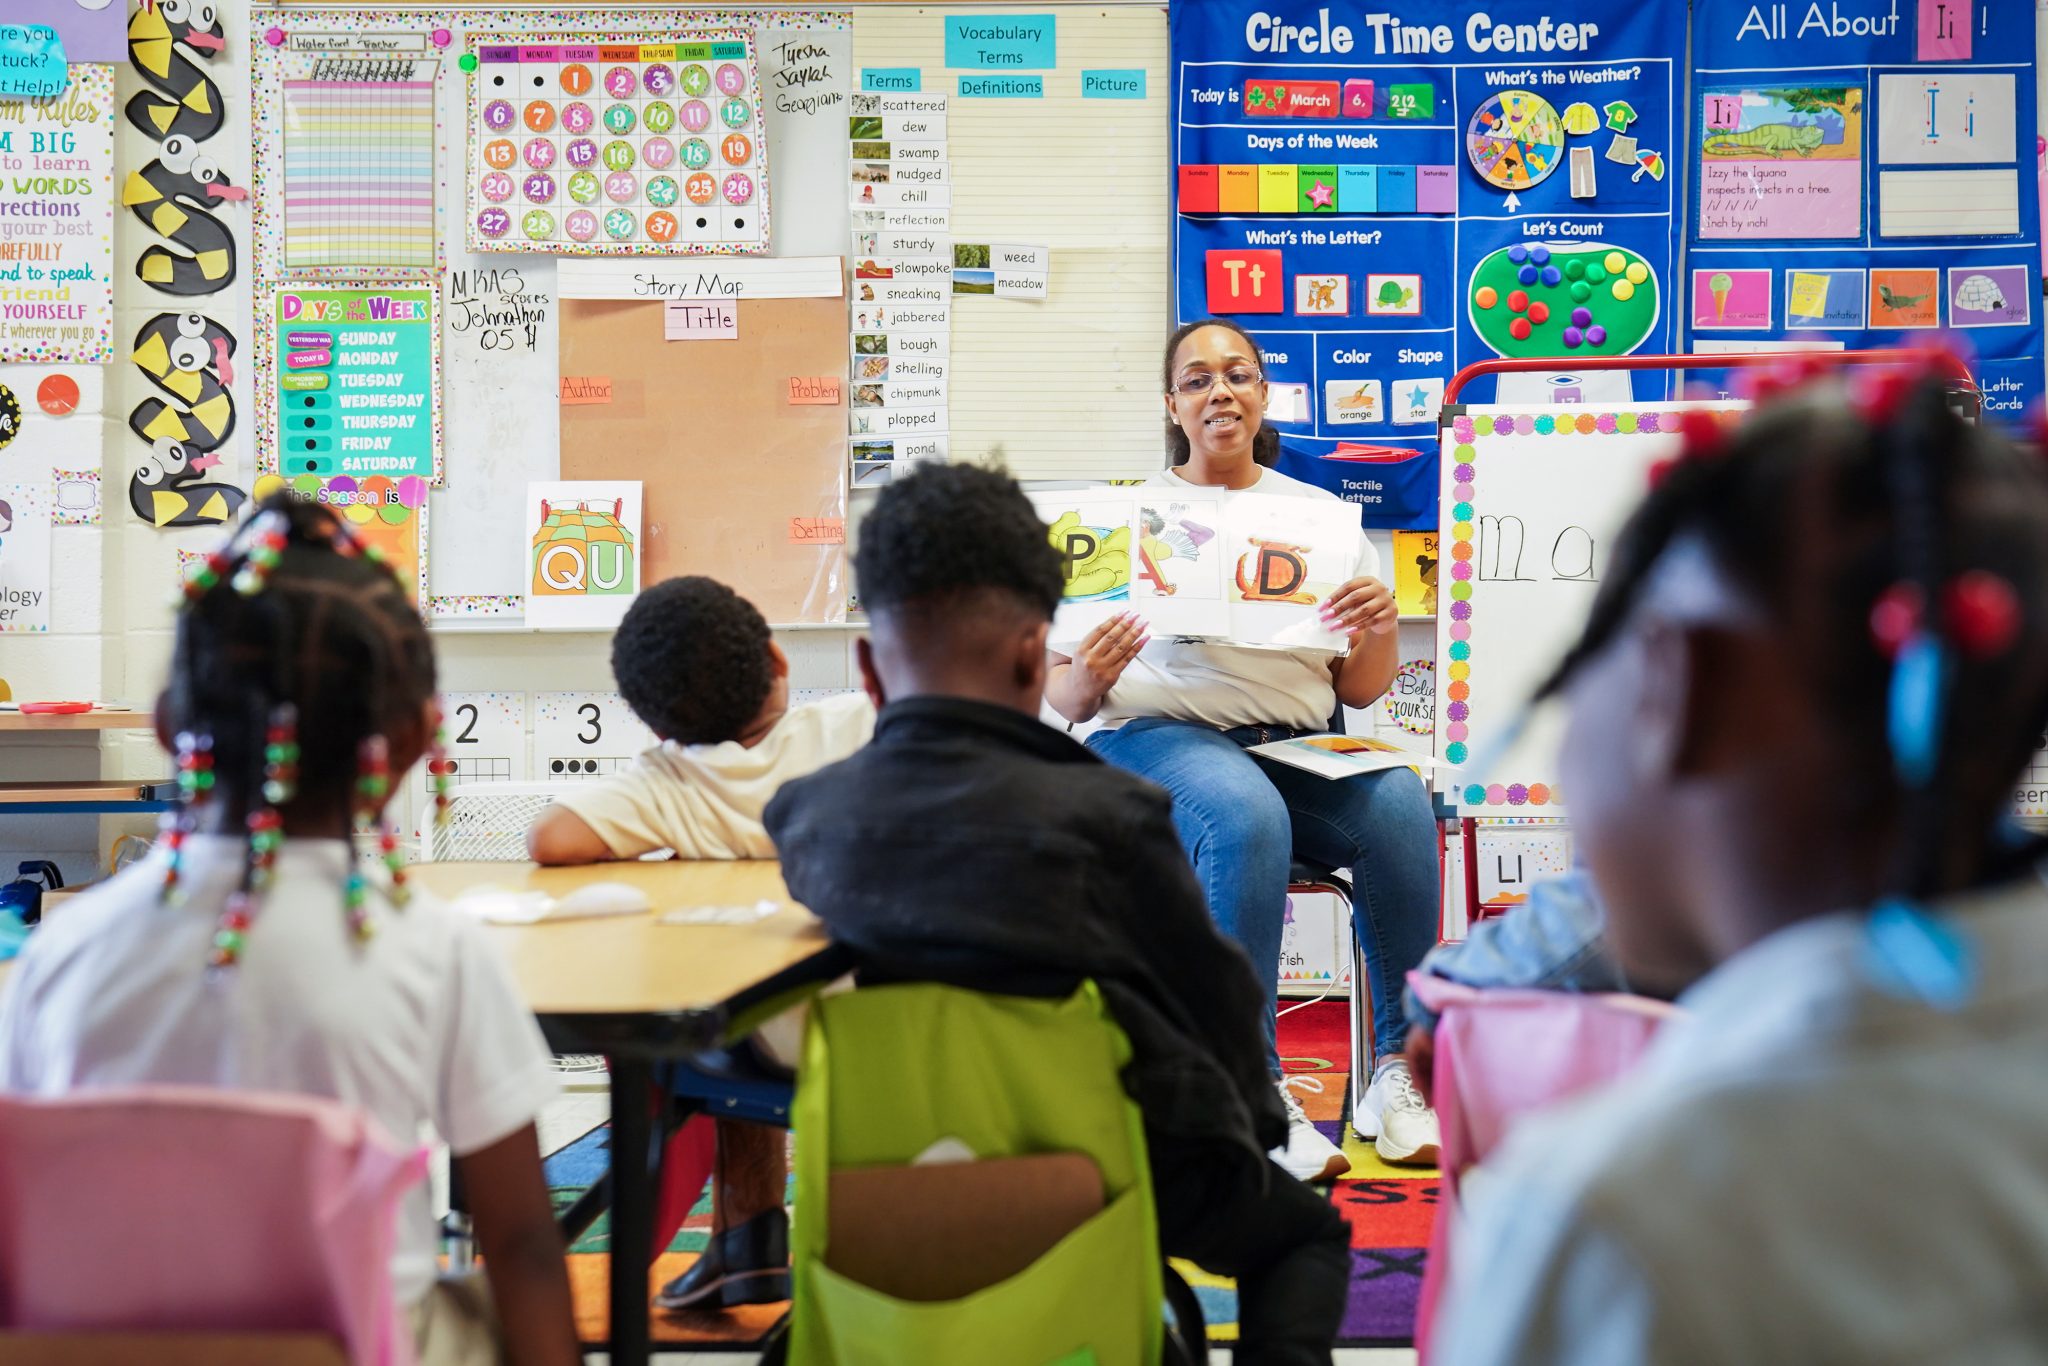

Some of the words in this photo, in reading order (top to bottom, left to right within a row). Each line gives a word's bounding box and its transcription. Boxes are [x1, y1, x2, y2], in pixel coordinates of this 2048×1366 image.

[1736, 4, 1786, 41] All
[1797, 0, 1900, 38] About
[24, 29, 54, 43] you
[959, 26, 1041, 42] Vocabulary
[1246, 8, 1354, 54] Circle
[1366, 13, 1453, 54] Time
[1466, 12, 1599, 53] Center
[526, 51, 553, 59] MONDAY
[565, 50, 594, 59] TUESDAY
[602, 51, 635, 60] WEDNESDAY
[643, 50, 674, 59] THURSDAY
[685, 49, 704, 57] FRIDAY
[714, 47, 744, 56] SATURDAY
[978, 51, 1023, 63] Terms
[572, 70, 581, 91] 1
[613, 74, 628, 94] 2
[651, 69, 667, 89] 3
[687, 71, 702, 91] 4
[723, 70, 738, 90] 5
[867, 74, 913, 88] Terms
[1486, 70, 1537, 85] What's
[1542, 70, 1566, 84] the
[1570, 66, 1641, 84] Weather?
[14, 80, 60, 97] Help!
[962, 81, 1041, 94] Definitions
[1087, 77, 1138, 91] Picture
[883, 99, 945, 111] scattered
[1191, 89, 1225, 105] Today
[1229, 88, 1239, 102] is
[1290, 94, 1330, 106] March
[1352, 93, 1366, 107] 6,
[492, 105, 506, 124] 6
[531, 106, 547, 126] 7
[570, 108, 585, 127] 8
[612, 109, 628, 129] 9
[649, 107, 669, 127] 10
[687, 106, 702, 125] 11
[726, 103, 745, 122] 12
[1713, 99, 1731, 124] Ii
[902, 121, 927, 133] dew
[29, 132, 76, 153] BIG
[1247, 134, 1284, 151] Days
[1287, 134, 1304, 149] of
[1308, 134, 1334, 148] the
[1336, 135, 1378, 149] Week
[489, 145, 511, 164] 13
[529, 144, 550, 163] 14
[571, 143, 593, 163] 15
[609, 146, 629, 166] 16
[649, 144, 667, 162] 17
[686, 143, 705, 163] 18
[726, 139, 746, 158] 19
[899, 147, 940, 159] swamp
[3, 155, 22, 170] to
[33, 155, 91, 170] learn
[897, 167, 941, 181] nudged
[1708, 166, 1728, 182] Izzy
[1733, 166, 1748, 177] the
[1753, 165, 1787, 182] Iguana
[13, 177, 92, 195] WORDS
[485, 177, 511, 197] 20
[529, 178, 550, 198] 21
[572, 176, 597, 198] 22
[609, 178, 634, 196] 23
[649, 182, 676, 203] 24
[689, 180, 713, 198] 25
[726, 178, 750, 198] 26
[1707, 182, 1745, 198] inspects
[1786, 185, 1793, 194] in
[1808, 182, 1831, 194] tree.
[901, 191, 928, 202] chill
[0, 199, 80, 217] rections
[481, 213, 506, 233] 27
[526, 214, 551, 234] 28
[570, 214, 594, 234] 29
[607, 211, 633, 235] 30
[652, 214, 673, 238] 31
[889, 214, 945, 225] reflection
[1707, 216, 1727, 227] Inch
[1731, 216, 1743, 232] by
[2, 222, 47, 240] your
[53, 219, 94, 236] best
[1523, 221, 1556, 236] Let's
[1560, 221, 1603, 236] Count
[893, 237, 935, 251] sturdy
[1246, 230, 1297, 245] What's
[1301, 230, 1326, 245] the
[1329, 230, 1382, 245] Letter?
[1004, 252, 1035, 263] weed
[27, 266, 45, 280] to
[50, 262, 96, 288] speak
[894, 263, 950, 277] slowpoke
[634, 273, 687, 299] Story
[696, 274, 743, 298] Map
[998, 278, 1044, 289] meadow
[1222, 260, 1265, 297] Tt
[887, 289, 941, 301] sneaking
[349, 298, 362, 309] of
[3, 304, 87, 319] YOURSELF
[346, 310, 366, 321] the
[670, 306, 735, 328] Title
[891, 312, 945, 325] jabbered
[1824, 310, 1860, 319] invitation
[10, 323, 57, 339] wherever
[60, 326, 79, 342] you
[83, 327, 94, 343] go
[338, 331, 397, 346] SUNDAY
[900, 338, 938, 353] bough
[338, 352, 399, 366] MONDAY
[1333, 350, 1371, 364] Color
[1398, 348, 1444, 366] Shape
[895, 363, 943, 378] shelling
[339, 373, 404, 388] TUESDAY
[561, 376, 610, 398] Author
[791, 376, 840, 398] Problem
[1982, 378, 2023, 392] Letter
[339, 394, 425, 408] WEDNESDAY
[890, 388, 941, 400] chipmunk
[1985, 396, 2023, 410] Cards
[888, 412, 936, 428] plopped
[1340, 410, 1372, 420] orange
[1410, 410, 1427, 418] star
[341, 415, 417, 429] THURSDAY
[341, 436, 392, 450] FRIDAY
[907, 442, 936, 456] pond
[342, 456, 417, 471] SATURDAY
[1342, 479, 1382, 491] Tactile
[318, 487, 378, 505] Season
[386, 488, 399, 503] is
[1341, 492, 1382, 504] Letters
[541, 544, 624, 591] QU
[1066, 534, 1096, 579] P
[1259, 550, 1301, 596] D
[456, 703, 479, 743] 2
[578, 703, 601, 744] 3
